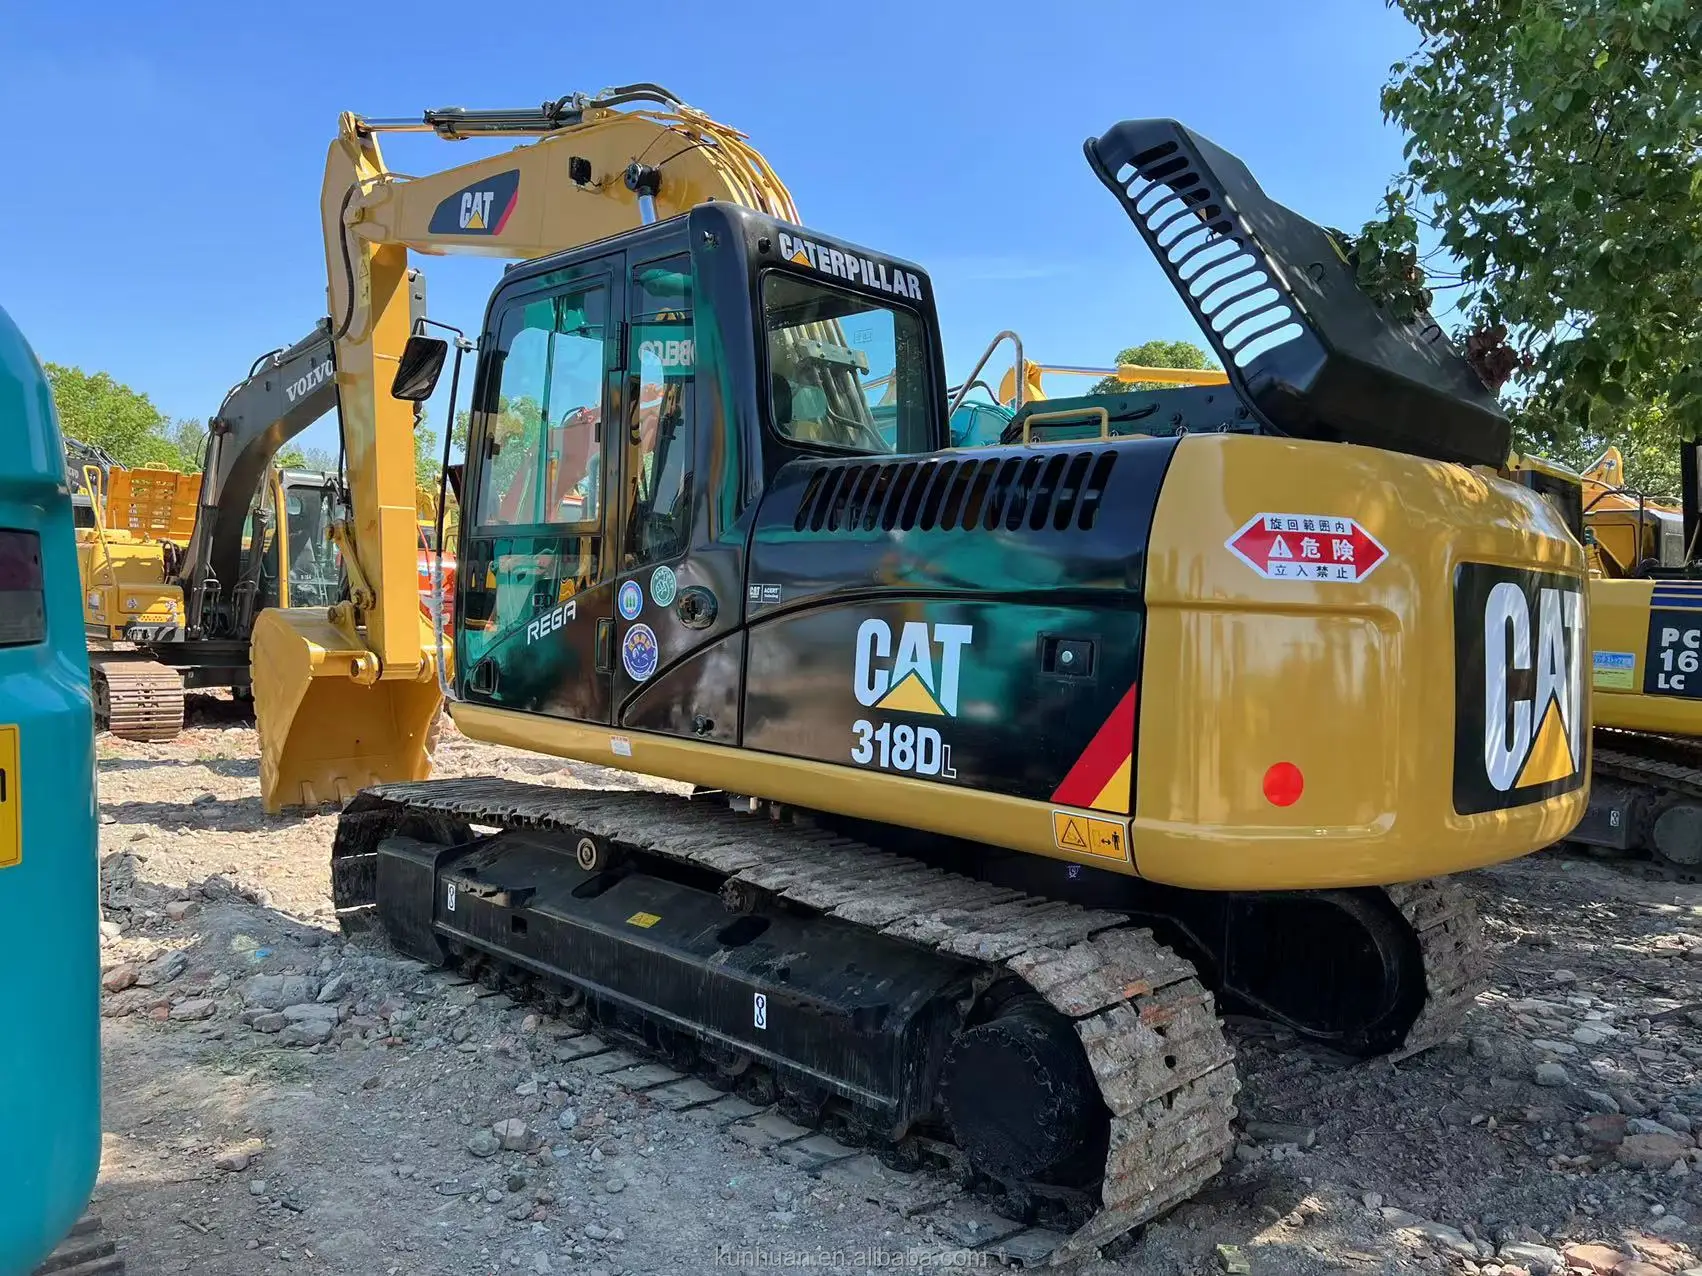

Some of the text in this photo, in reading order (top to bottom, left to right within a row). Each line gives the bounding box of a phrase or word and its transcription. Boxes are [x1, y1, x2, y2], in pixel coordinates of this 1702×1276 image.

[459, 191, 494, 230] CAT
[778, 232, 923, 301] CATERPILLAR
[285, 359, 334, 402] VOLVO
[1274, 564, 1349, 580] 立入禁止
[527, 600, 577, 646] REGA
[1661, 627, 1701, 649] PC
[853, 618, 973, 717] CAT
[1484, 582, 1584, 792] CAT
[1657, 673, 1685, 690] LC
